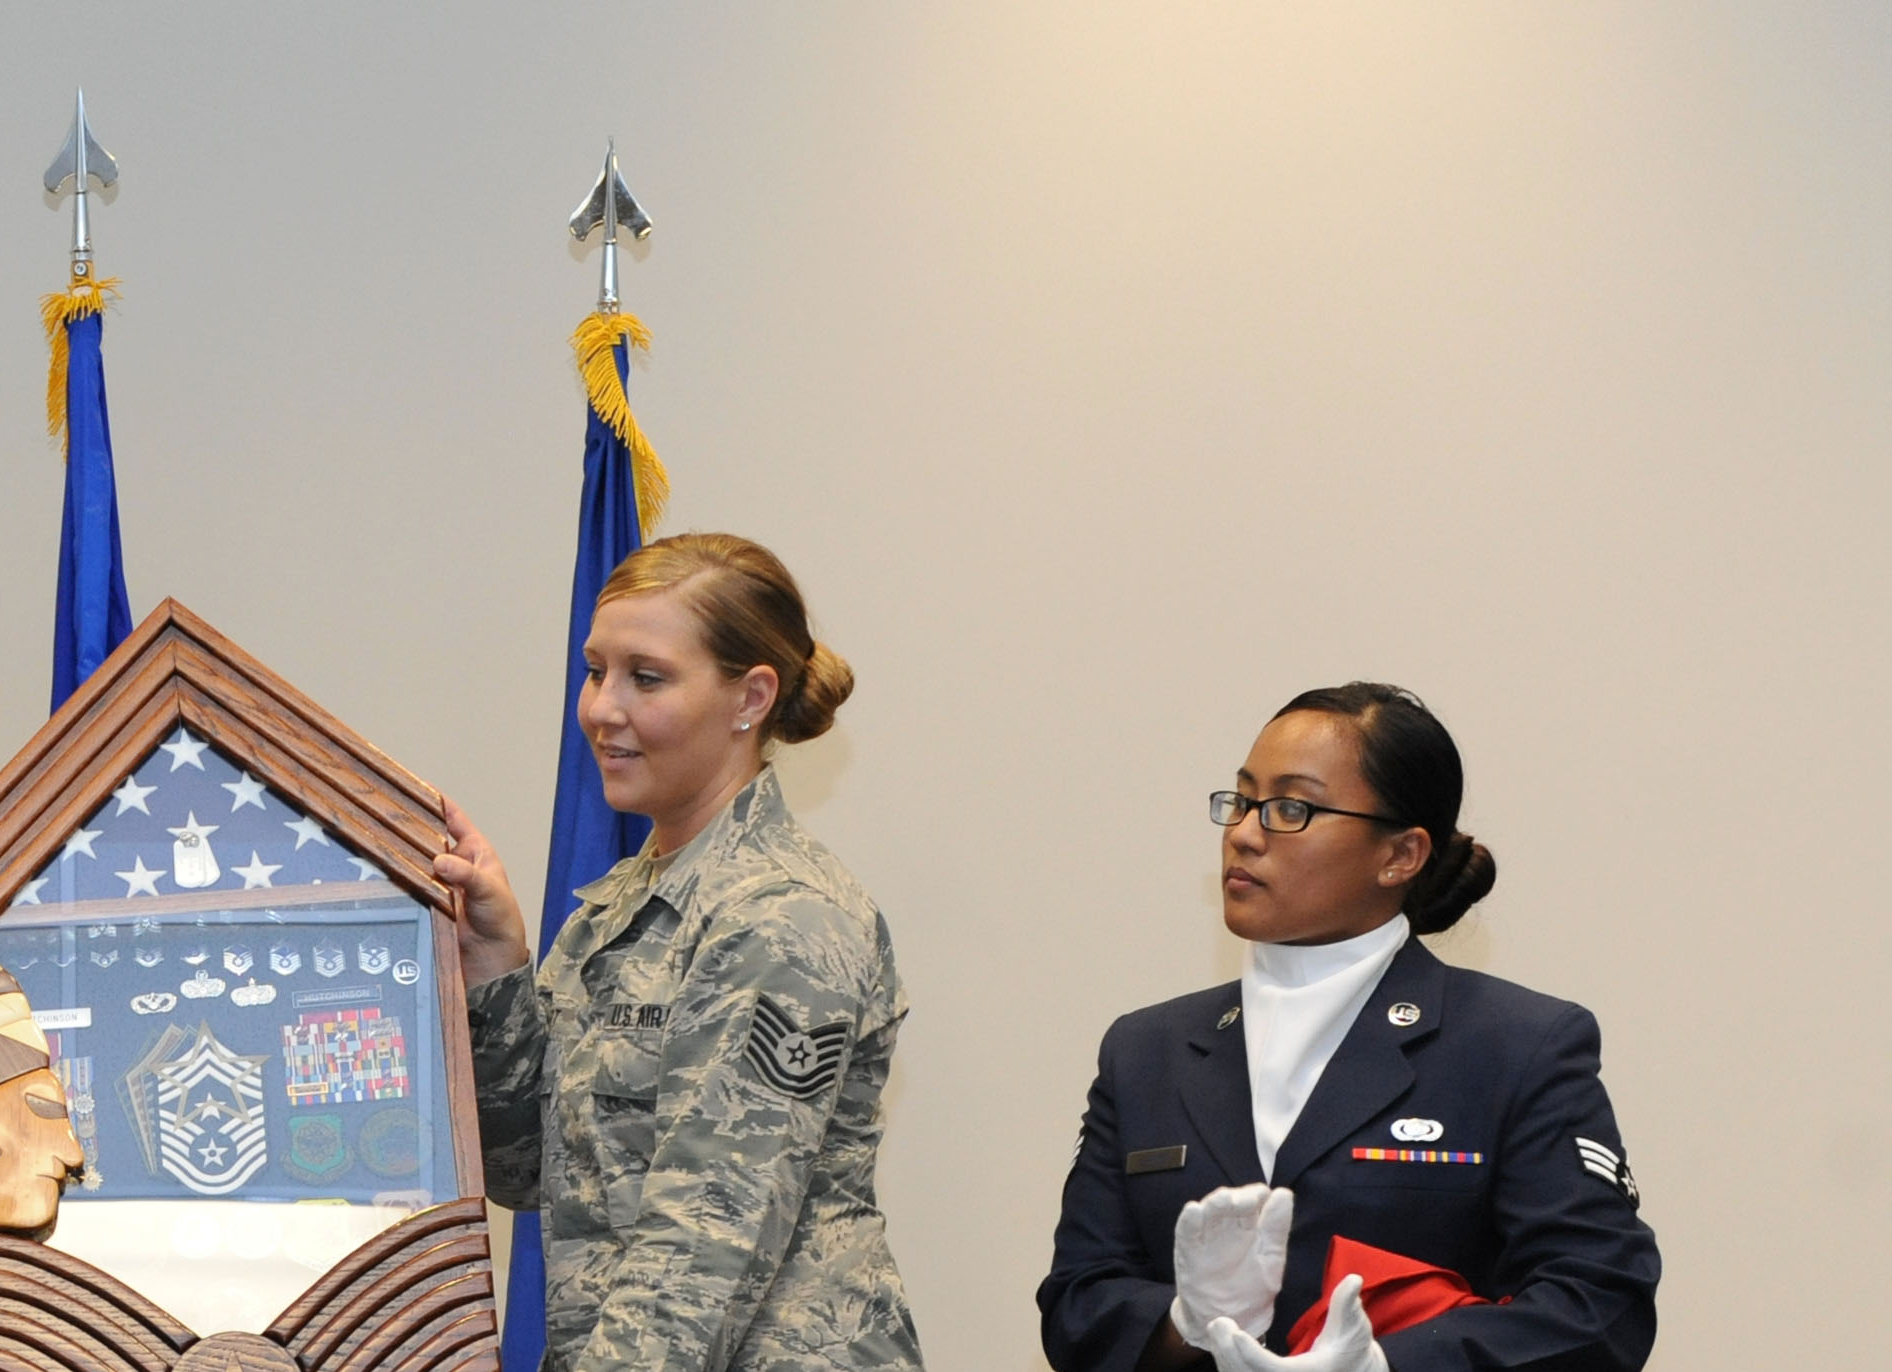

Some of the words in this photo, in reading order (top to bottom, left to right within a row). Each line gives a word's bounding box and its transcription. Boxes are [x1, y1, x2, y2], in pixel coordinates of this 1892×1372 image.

[33, 1012, 78, 1025] TCHINSON
[611, 1003, 634, 1027] U.S.
[636, 1003, 662, 1028] AIR
